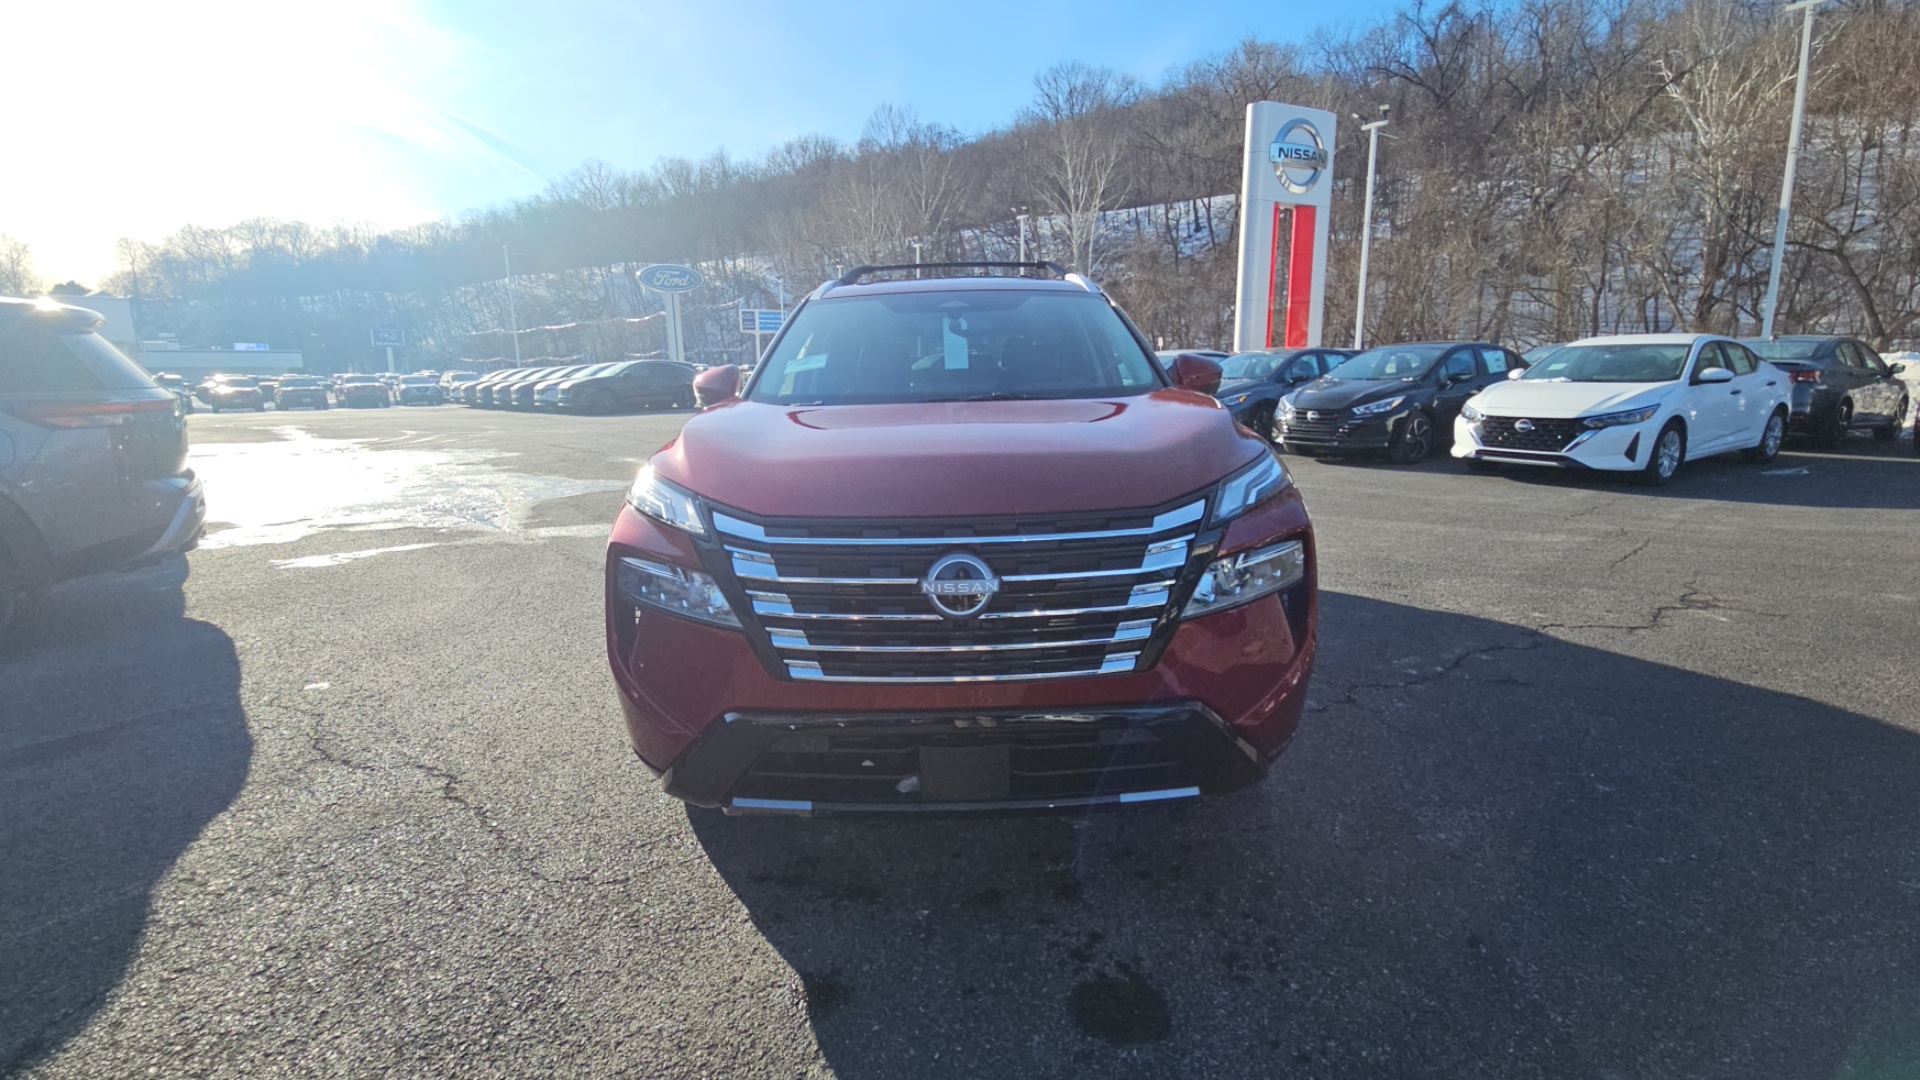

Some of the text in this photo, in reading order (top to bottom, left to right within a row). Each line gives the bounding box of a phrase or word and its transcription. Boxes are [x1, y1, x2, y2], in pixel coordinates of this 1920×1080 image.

[1278, 147, 1324, 163] NISSAN
[653, 270, 689, 286] Ford
[923, 581, 997, 593] NISSAN
